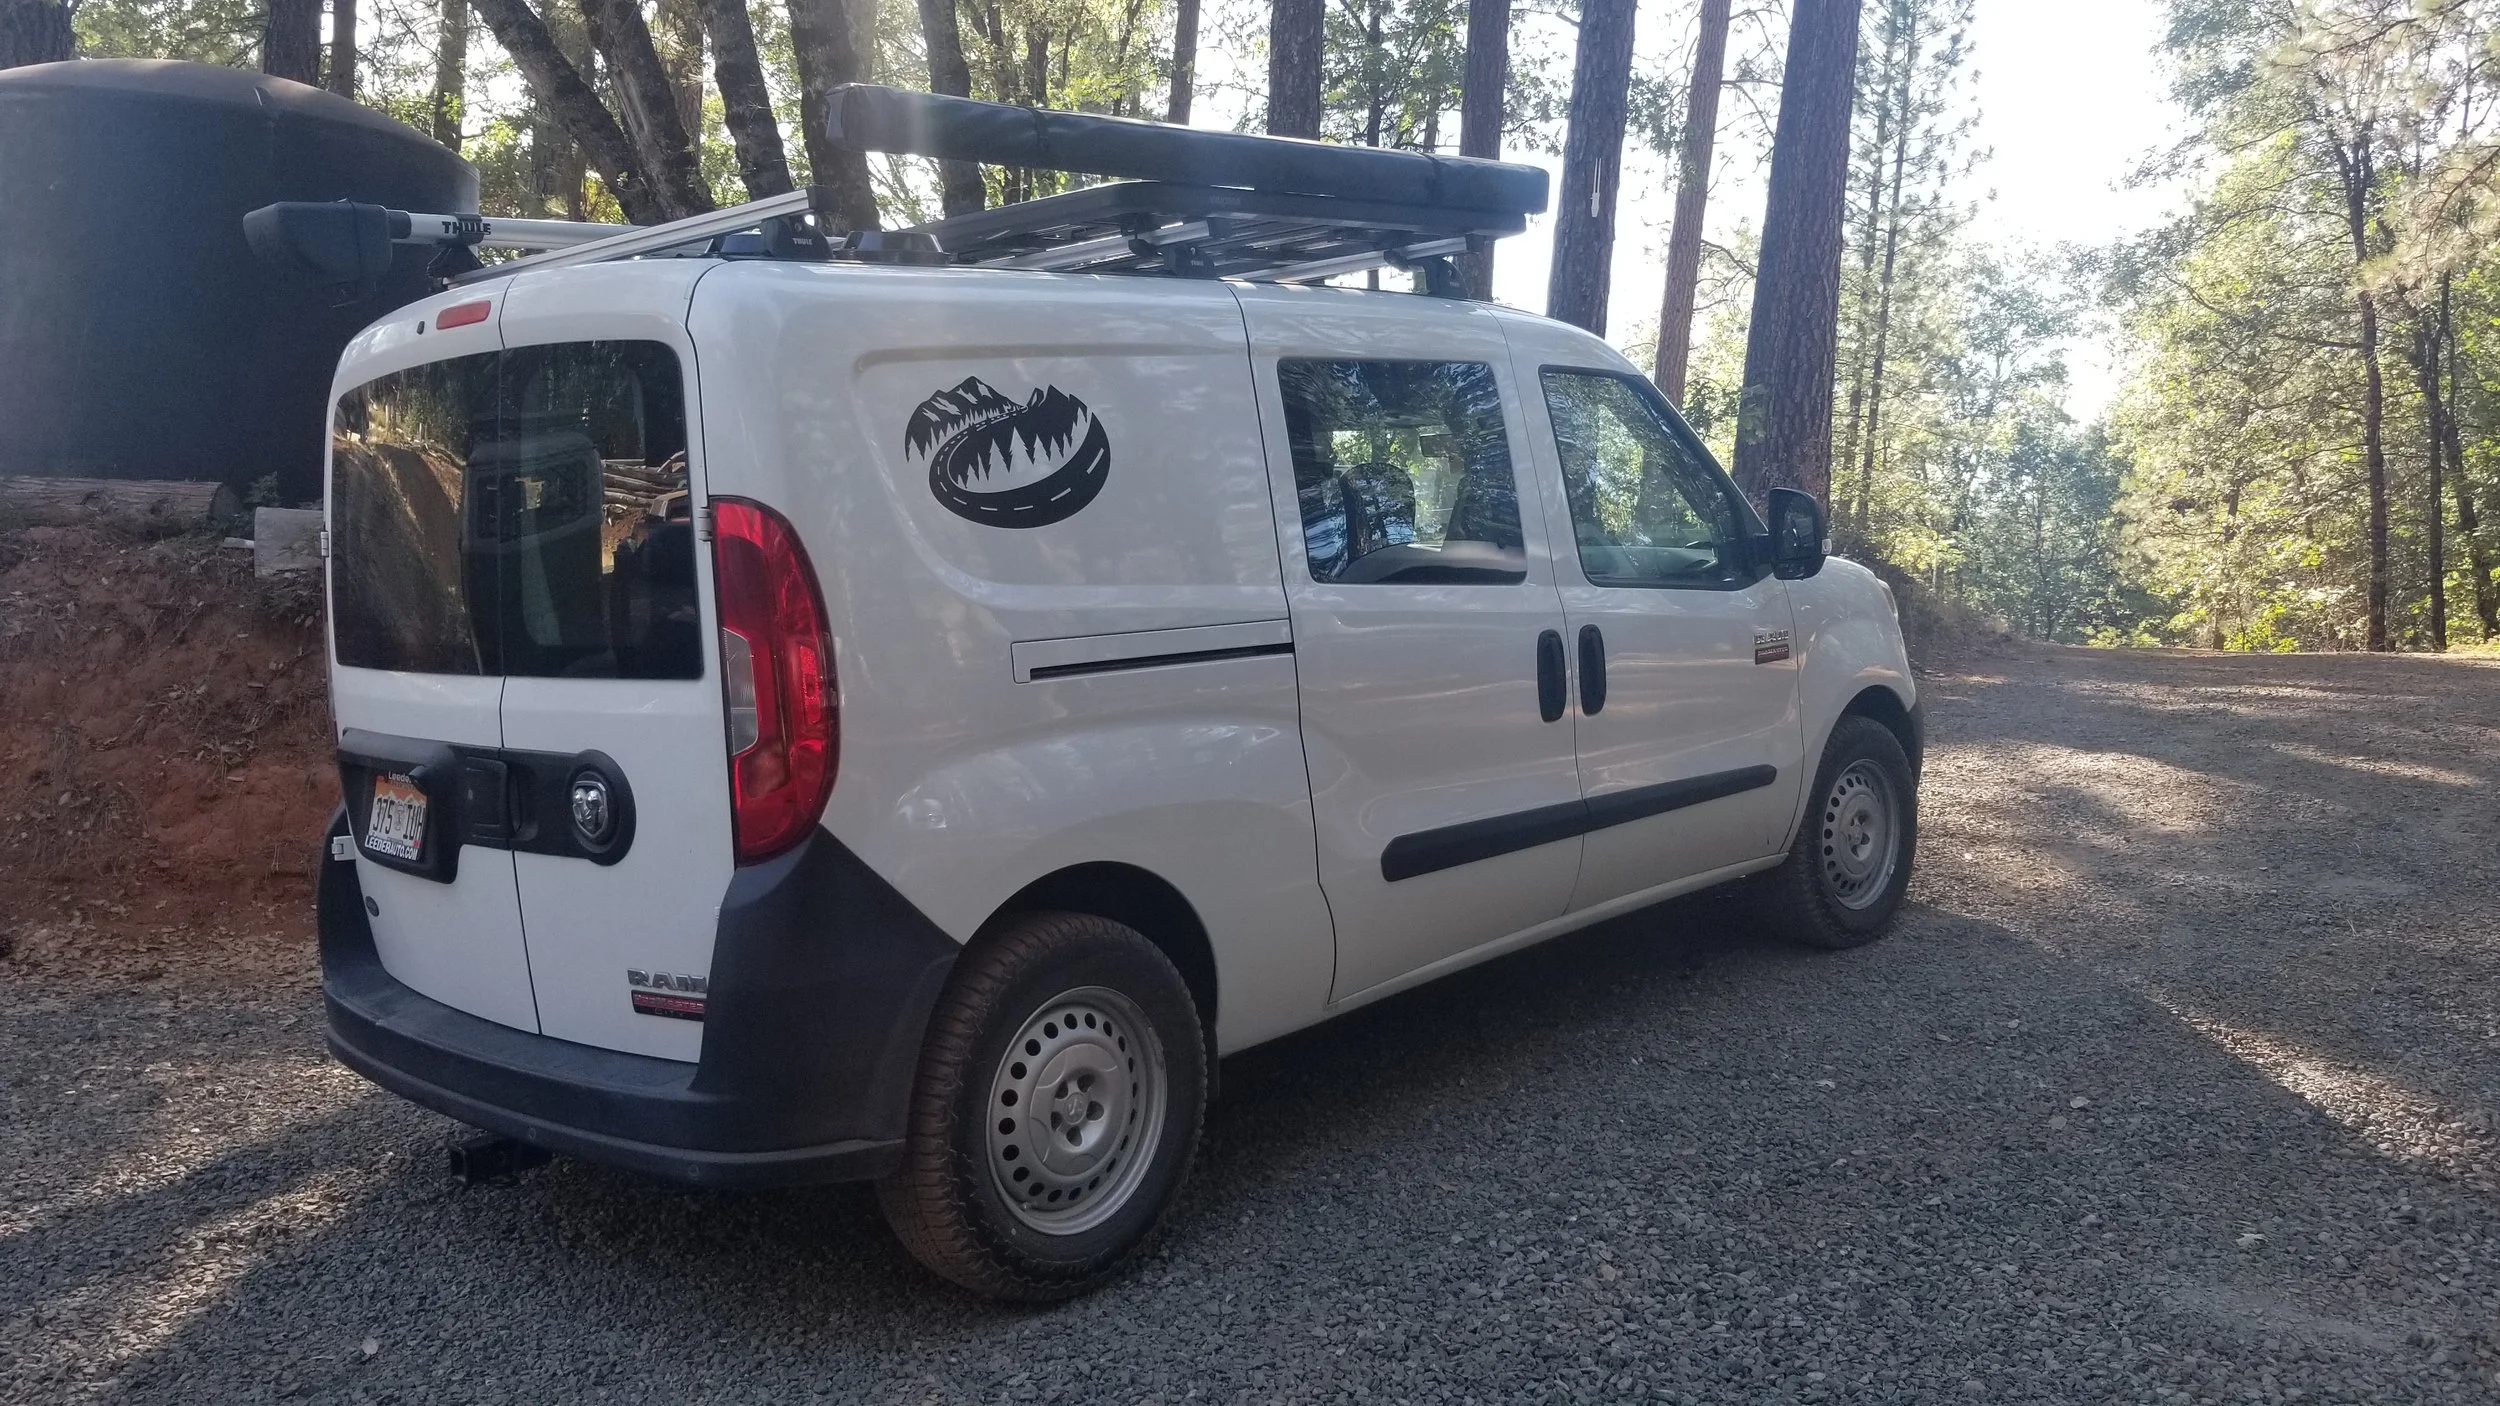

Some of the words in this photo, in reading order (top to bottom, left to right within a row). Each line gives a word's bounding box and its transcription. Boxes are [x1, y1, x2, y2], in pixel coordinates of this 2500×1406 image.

[442, 221, 492, 236] THULE
[388, 770, 412, 784] Leede
[373, 797, 395, 834] 375
[364, 835, 418, 861] LEEDERAUTO.COM
[627, 968, 708, 993] RAM
